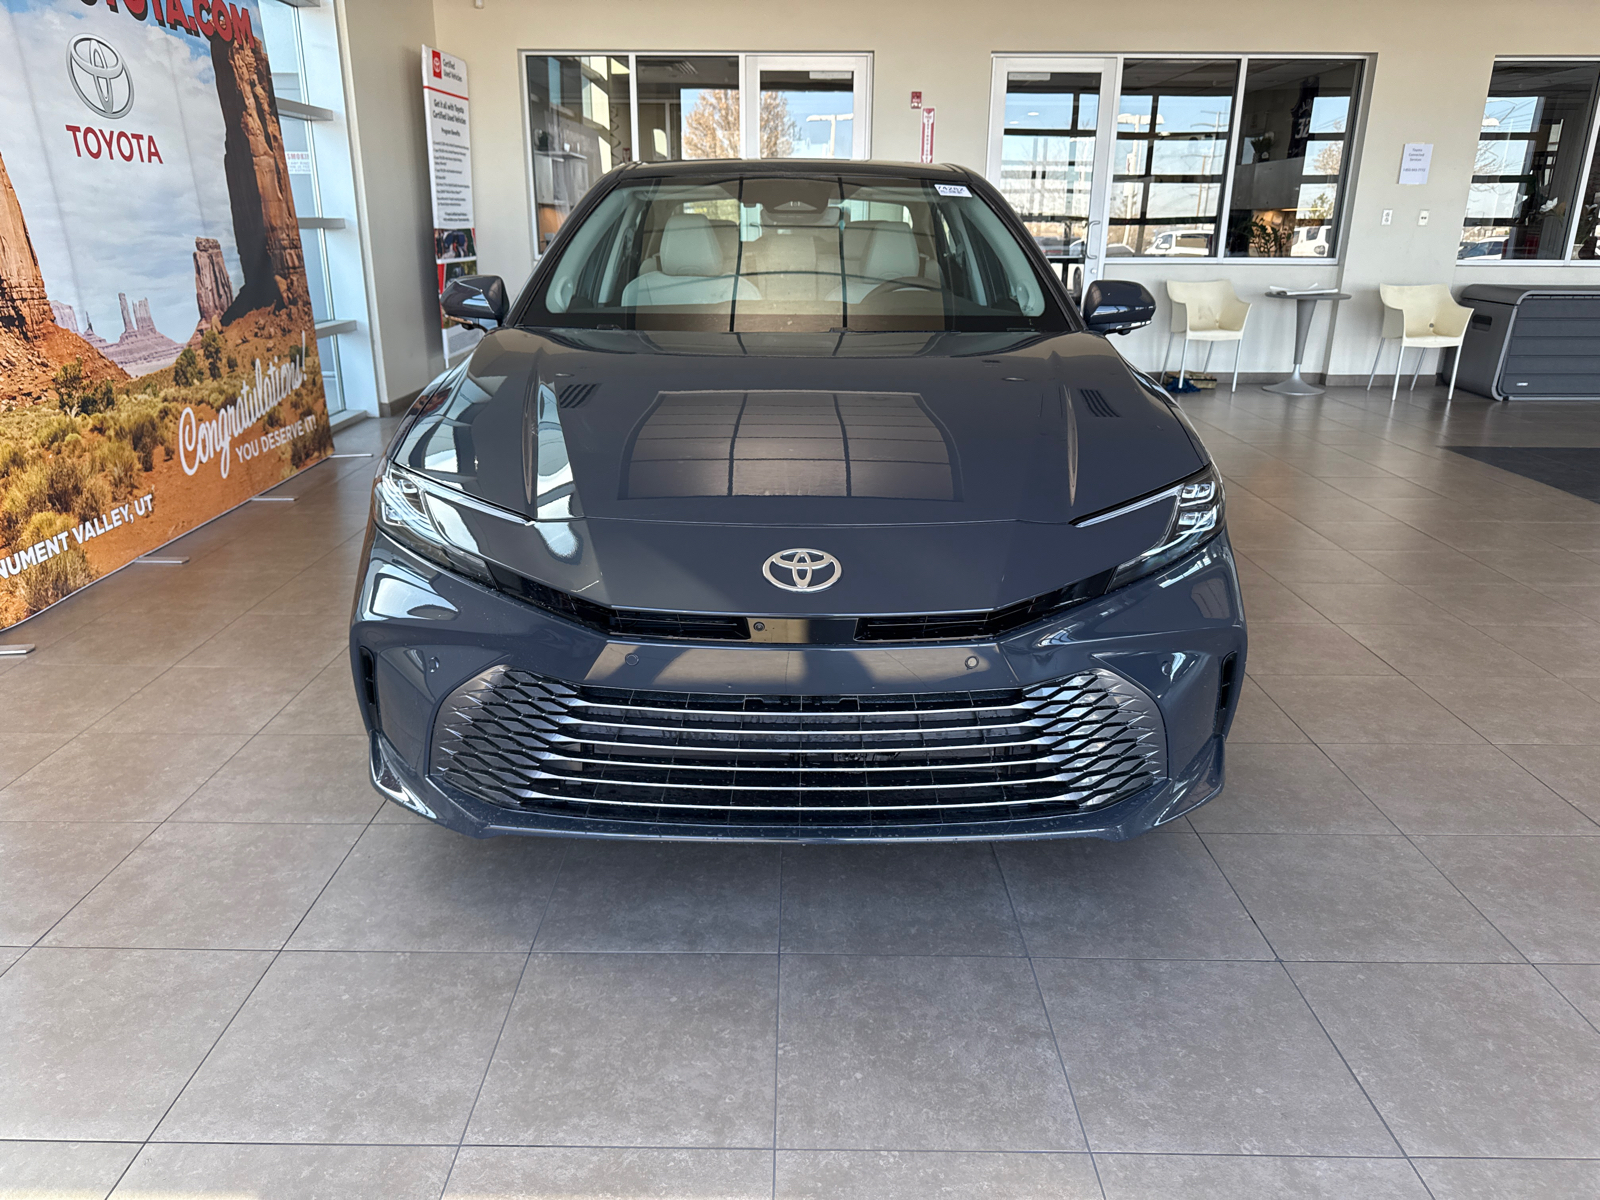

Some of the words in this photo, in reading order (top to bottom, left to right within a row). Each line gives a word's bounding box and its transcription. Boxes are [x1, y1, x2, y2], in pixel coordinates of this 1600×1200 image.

[442, 58, 456, 70] Certified
[451, 71, 463, 82] Vehicles
[432, 109, 447, 121] Certified
[454, 115, 467, 125] Vehicles
[454, 104, 465, 115] Toyota
[65, 124, 164, 165] TOYOTA
[179, 330, 307, 479] Congratulations!
[235, 438, 260, 463] YOU
[260, 420, 305, 453] DESERVE
[303, 414, 318, 433] IT!
[71, 503, 135, 545] VALLEY,
[133, 493, 154, 517] UT
